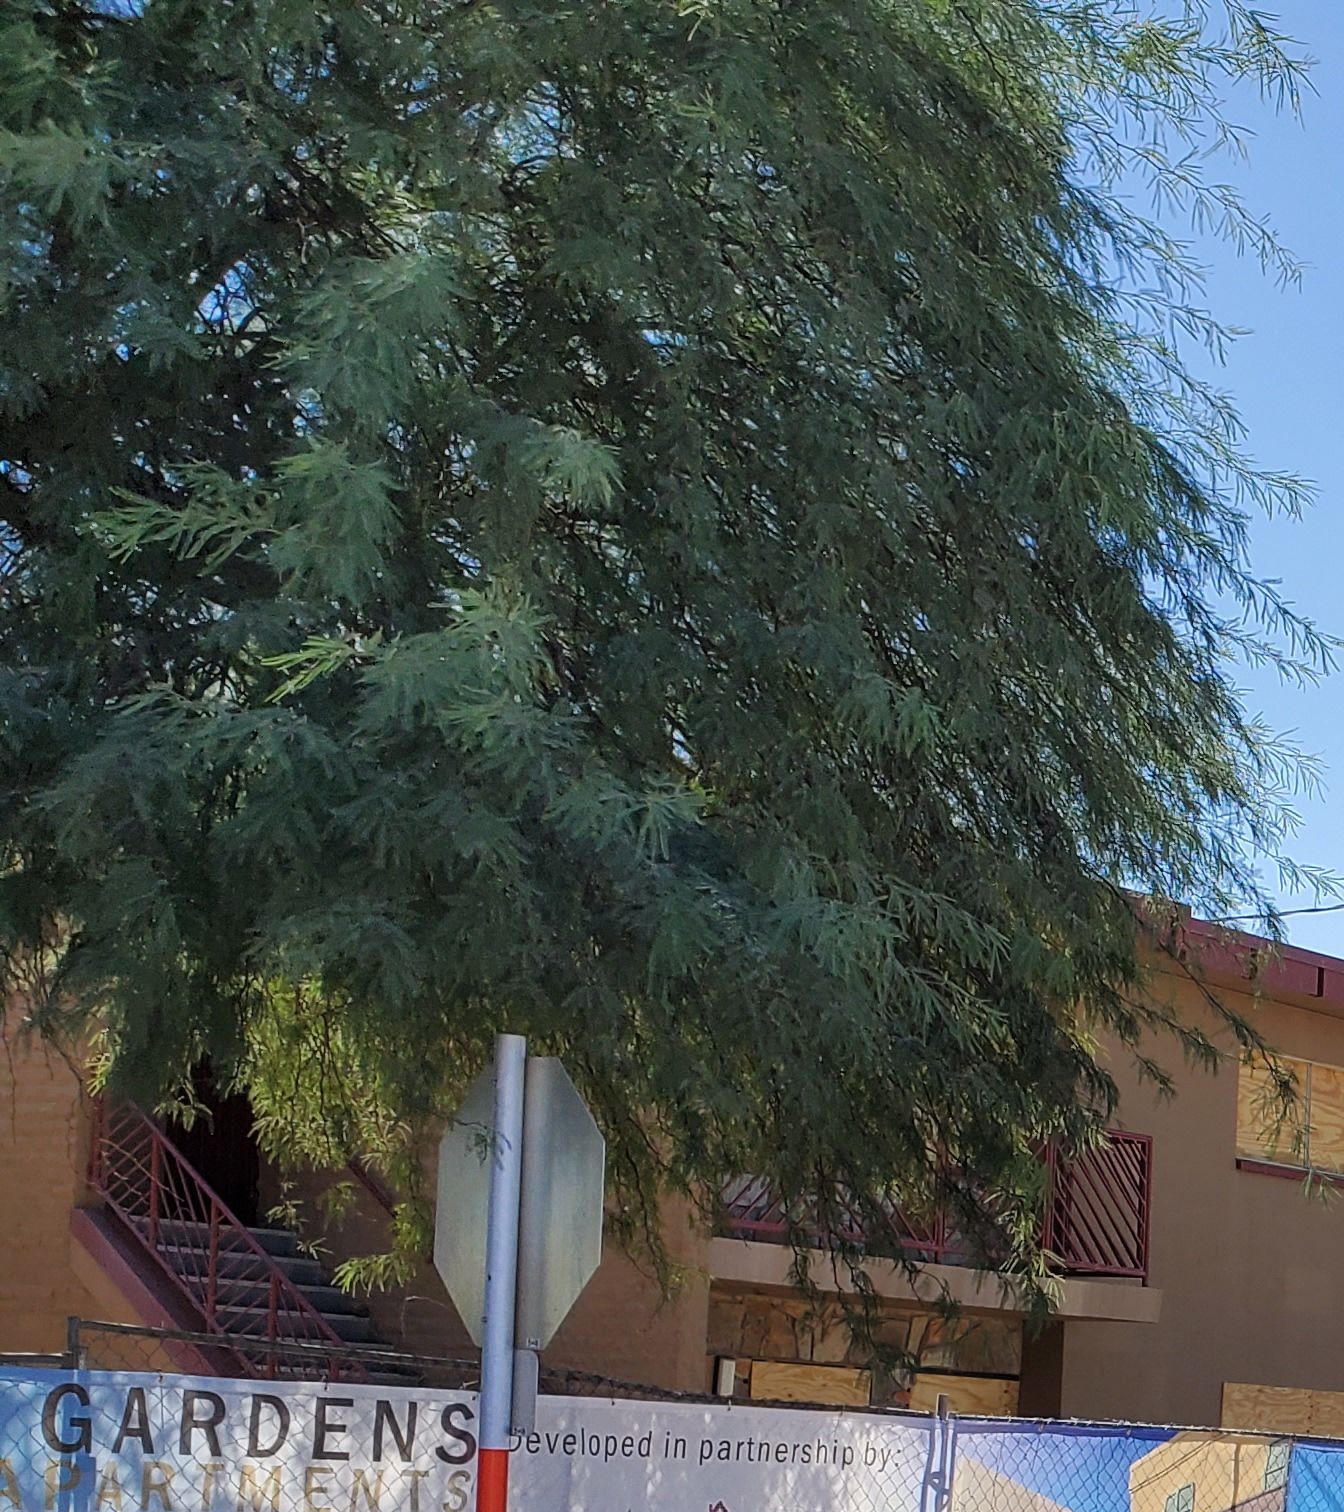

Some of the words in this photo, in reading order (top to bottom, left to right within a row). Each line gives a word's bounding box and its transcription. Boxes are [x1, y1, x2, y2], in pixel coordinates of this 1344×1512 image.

[42, 1383, 477, 1465] GARDENS
[664, 1431, 687, 1459] in
[699, 1436, 855, 1468] partnership
[864, 1441, 901, 1473] by:
